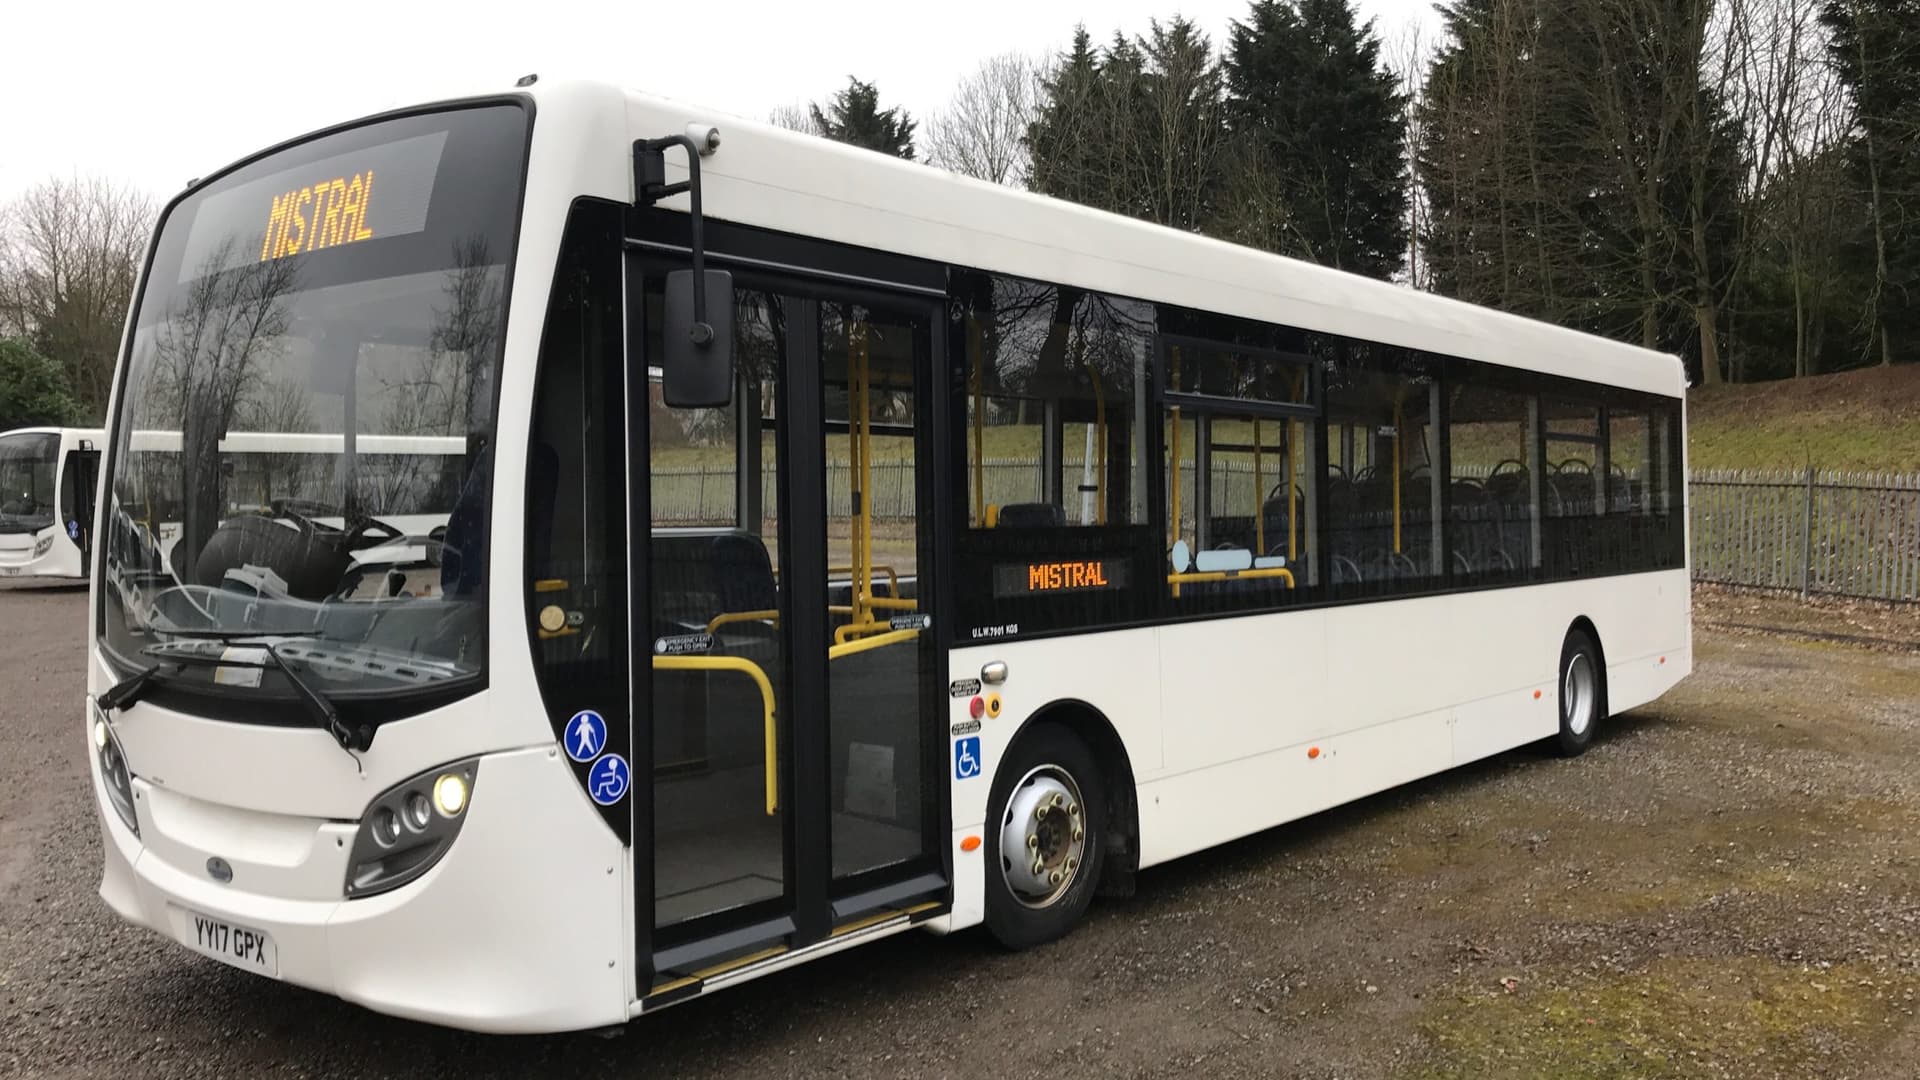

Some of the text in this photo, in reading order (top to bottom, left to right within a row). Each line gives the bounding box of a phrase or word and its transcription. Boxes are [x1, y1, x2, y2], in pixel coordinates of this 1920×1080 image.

[261, 169, 373, 261] MISTRAL
[1029, 562, 1108, 590] MISTRAL
[195, 916, 265, 965] YY17 GPX
